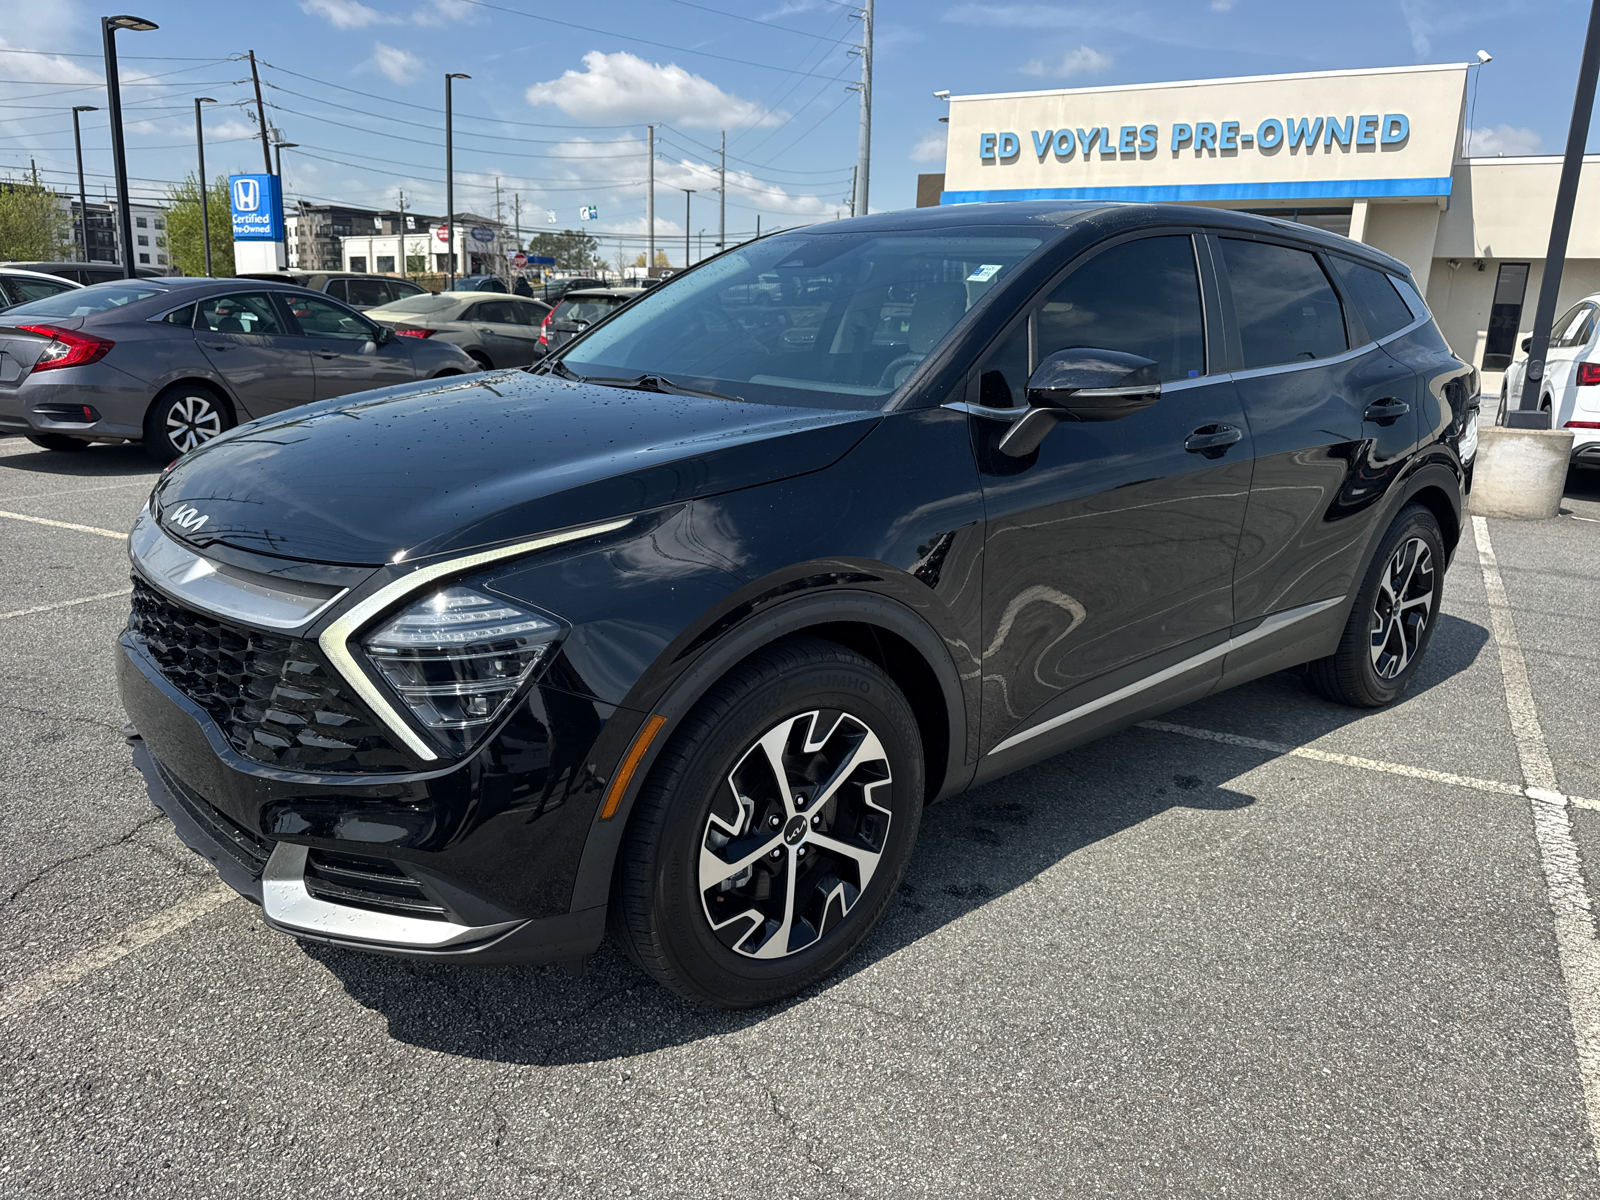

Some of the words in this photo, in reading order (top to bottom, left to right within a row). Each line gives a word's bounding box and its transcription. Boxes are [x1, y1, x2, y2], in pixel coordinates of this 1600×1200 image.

[979, 131, 1021, 159] ED
[1031, 123, 1158, 157] VOYLES
[1170, 113, 1410, 152] PRE-OWNED
[232, 213, 270, 224] Certified
[233, 224, 271, 234] Pre-Owned
[808, 674, 871, 694] KUMHO
